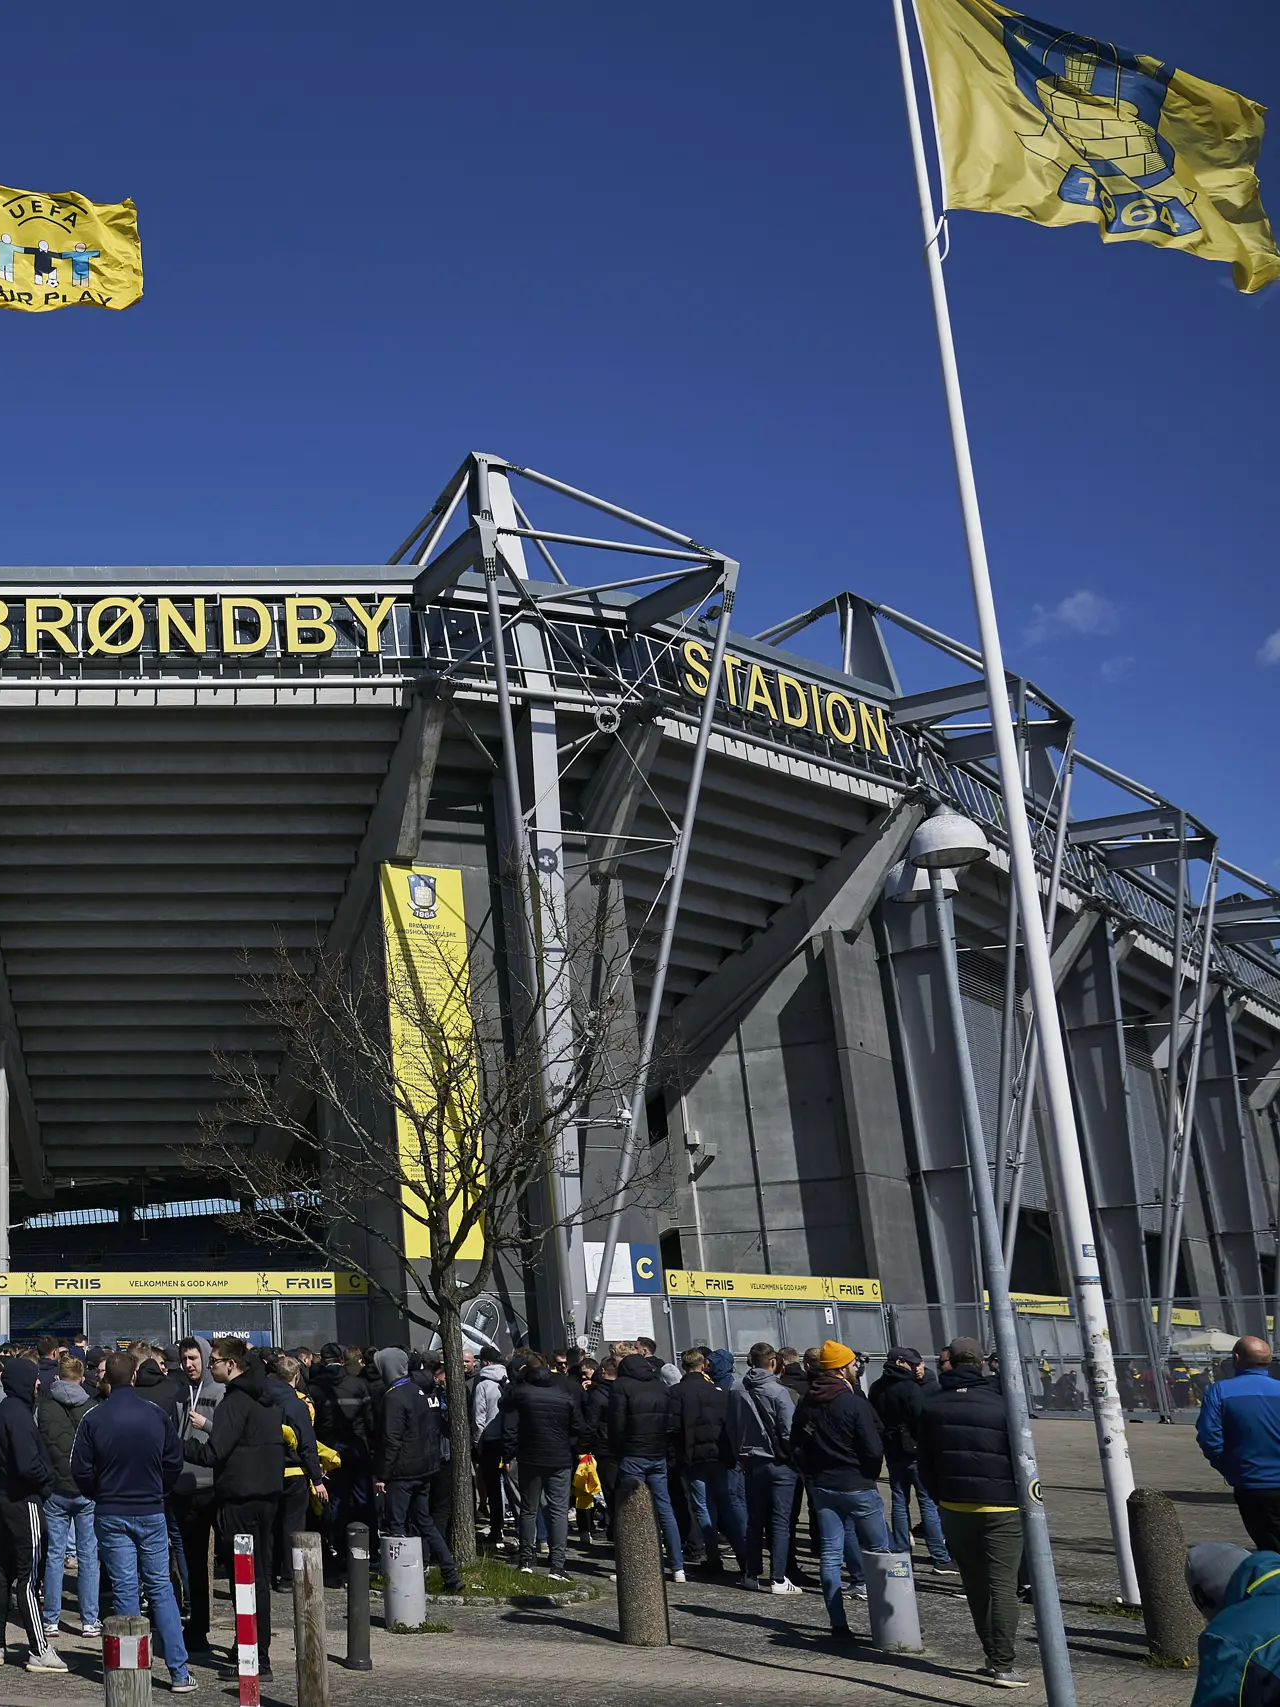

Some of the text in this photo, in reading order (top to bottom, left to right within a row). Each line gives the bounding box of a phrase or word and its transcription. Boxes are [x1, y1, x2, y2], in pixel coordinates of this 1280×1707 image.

[1077, 176, 1181, 233] 1964
[9, 200, 77, 228] UEFA
[44, 290, 113, 307] PLAY
[681, 639, 889, 757] STADION
[415, 911, 434, 919] 1964
[637, 1257, 654, 1279] C
[55, 1278, 101, 1289] FRIIS
[286, 1278, 333, 1289] FRIIS
[349, 1274, 361, 1288] C
[669, 1274, 677, 1288] C
[705, 1279, 734, 1291] FRIIS
[750, 1283, 779, 1291] VELKOMMEN
[840, 1285, 864, 1295] FRIIS
[872, 1283, 878, 1296] C
